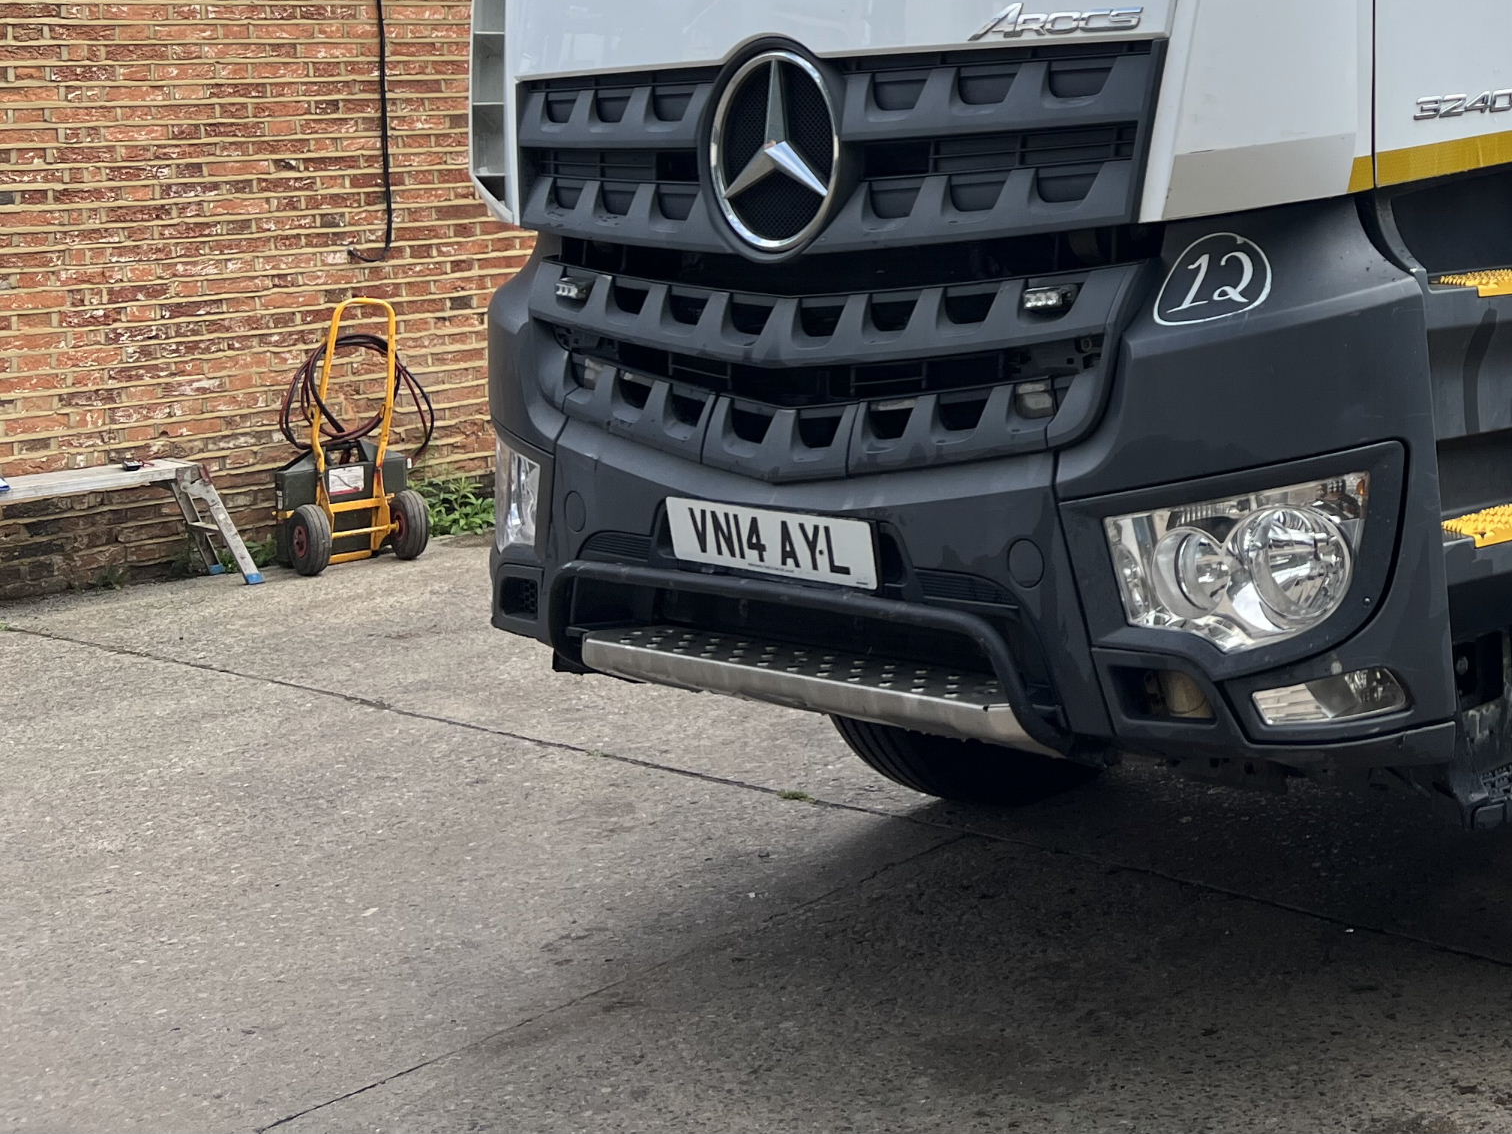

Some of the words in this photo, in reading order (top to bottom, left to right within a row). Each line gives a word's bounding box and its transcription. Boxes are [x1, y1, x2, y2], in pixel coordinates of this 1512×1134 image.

[1166, 251, 1254, 314] 12
[687, 507, 767, 563] VN14
[780, 519, 852, 576] AYL
